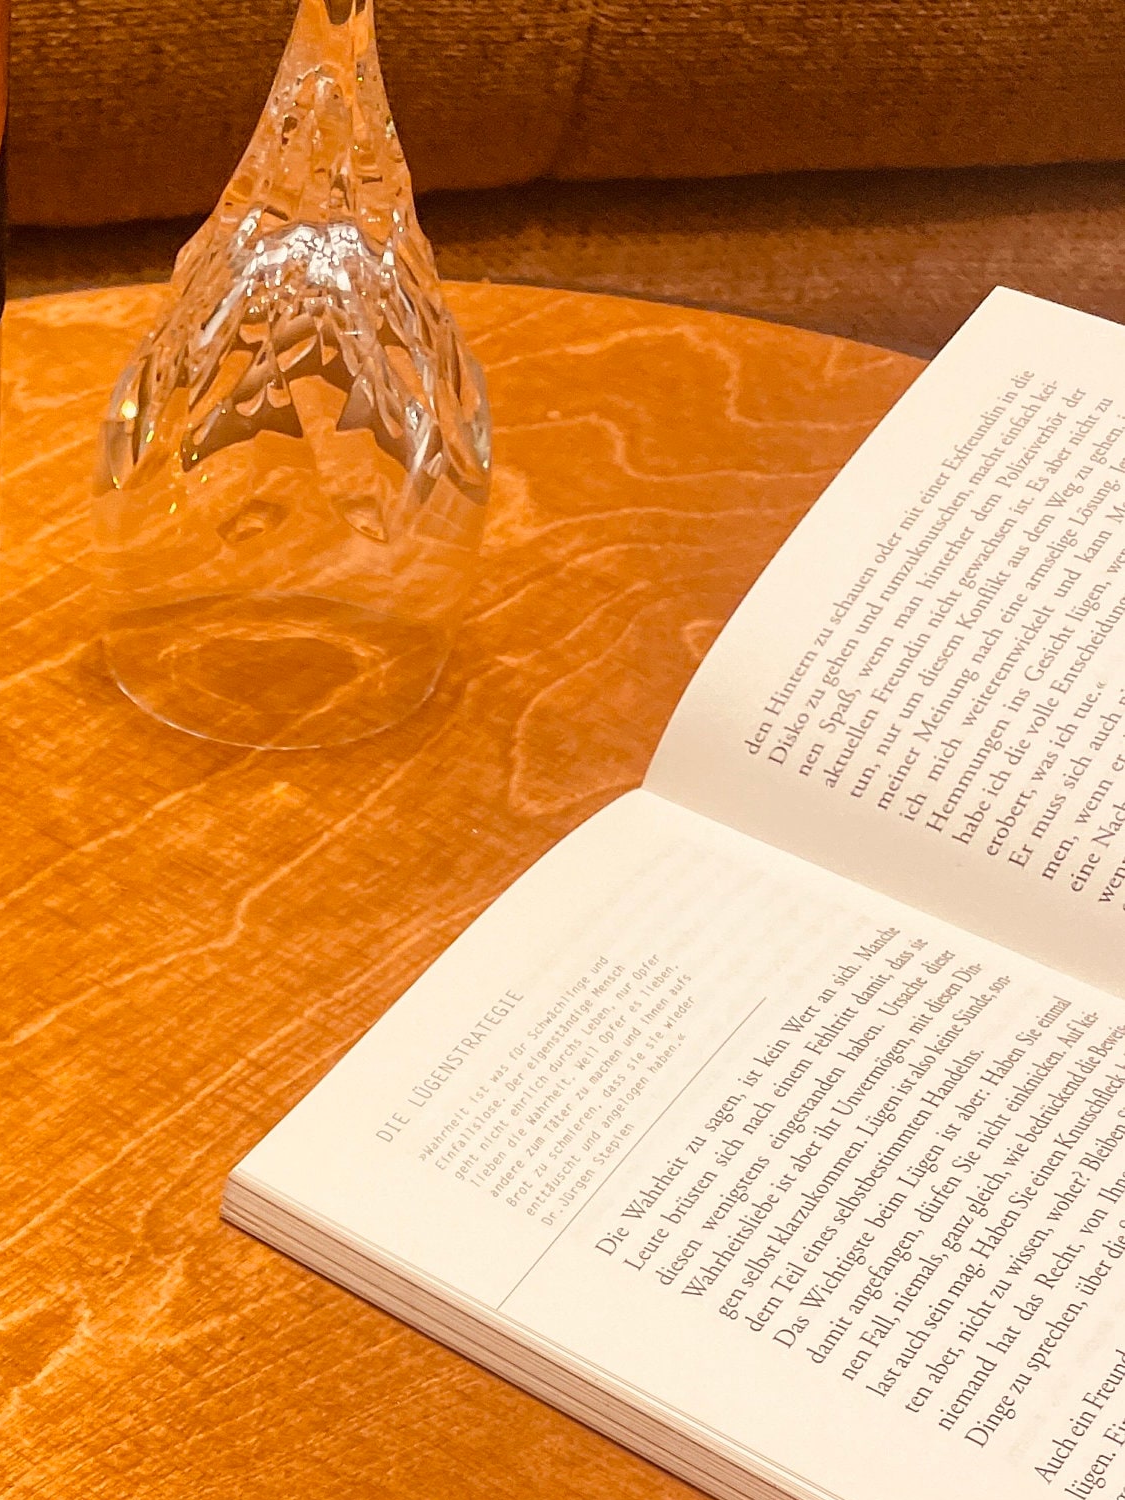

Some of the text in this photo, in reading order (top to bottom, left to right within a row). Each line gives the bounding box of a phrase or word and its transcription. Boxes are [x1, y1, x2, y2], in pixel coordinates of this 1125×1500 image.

[744, 371, 1035, 755] den Hintern zu schauen oder mit einer Exfreundin in die
[767, 713, 810, 765] Disko
[805, 688, 826, 709] zu
[822, 639, 859, 687] gehen
[855, 602, 884, 634] und
[968, 447, 1005, 485] macht
[1000, 404, 1041, 446] einfach
[1029, 380, 1057, 402] kei-
[799, 743, 825, 777] nen
[858, 636, 894, 677] wenn
[893, 596, 924, 629] man
[915, 526, 975, 590] hinterher
[970, 494, 1002, 522] dem
[994, 412, 1067, 488] Polizeiverhör
[1061, 388, 1087, 408] der
[823, 709, 879, 788] aktuellen
[870, 633, 931, 704] Freundin
[927, 590, 962, 628] nicht
[958, 518, 1018, 590] gewachsen
[1025, 477, 1050, 493] Es
[1043, 447, 1072, 475] aber
[1068, 414, 1100, 446] nicht
[1095, 398, 1114, 413] zu
[899, 530, 1113, 821] ich mich weiterentwickelt und kann
[925, 719, 1011, 833] Hemmungen
[1002, 688, 1031, 713] ins
[1024, 626, 1075, 682] Gesicht
[1031, 751, 1059, 781] was
[1049, 724, 1079, 749] ich
[1070, 853, 1101, 892] eine
[1074, 779, 1114, 823] wenn
[375, 989, 524, 1143] DIE LÜGENSTRATEGIE
[594, 1227, 630, 1256] Die
[620, 1157, 688, 1219] Wahrheit
[685, 1136, 707, 1154] zu
[737, 1069, 763, 1087] ist
[753, 1039, 791, 1067] kein
[780, 1005, 821, 1033] Wert
[817, 988, 837, 1004] an
[853, 927, 901, 961] Manche
[655, 1239, 703, 1286] diesen
[701, 1156, 770, 1230] wenigstens
[769, 1067, 846, 1150] eingestanden
[877, 977, 928, 1016] Ursache
[921, 950, 956, 974] dieser
[772, 1316, 810, 1349] Das
[799, 1232, 875, 1308] Wichtigste
[864, 1192, 908, 1229] beim
[896, 1145, 945, 1188] Lügen
[935, 1123, 962, 1142] ist
[979, 1048, 1026, 1086] Haben
[1015, 1029, 1042, 1046] Sie
[1036, 996, 1072, 1028] einmal
[806, 1316, 853, 1364] damit
[914, 1176, 962, 1223] dürfen
[951, 1151, 981, 1173] Sie
[976, 1114, 1011, 1150] nicht
[1057, 1023, 1085, 1048] Auf
[1071, 1012, 1099, 1028] kei-
[744, 1297, 784, 1332] dern
[770, 1261, 808, 1293] Teil
[802, 1225, 838, 1263] eines
[833, 1109, 933, 1225] selbstbestimmten
[867, 1367, 902, 1398] last
[895, 1330, 931, 1369] auch
[924, 1298, 955, 1330] sein
[969, 1210, 1021, 1259] Haben
[1008, 1186, 1038, 1209] Sie
[1030, 1150, 1067, 1187] einen
[1053, 1074, 1125, 1150] Knutschfleck
[938, 1356, 998, 1431] niemand
[987, 1326, 1021, 1354] hat
[1016, 1294, 1044, 1321] das
[1079, 1209, 1109, 1234] von
[966, 1395, 1016, 1448] Dinge
[1009, 1373, 1032, 1395] zu
[1075, 1259, 1112, 1295] über
[1036, 1411, 1097, 1484] Auch ein
